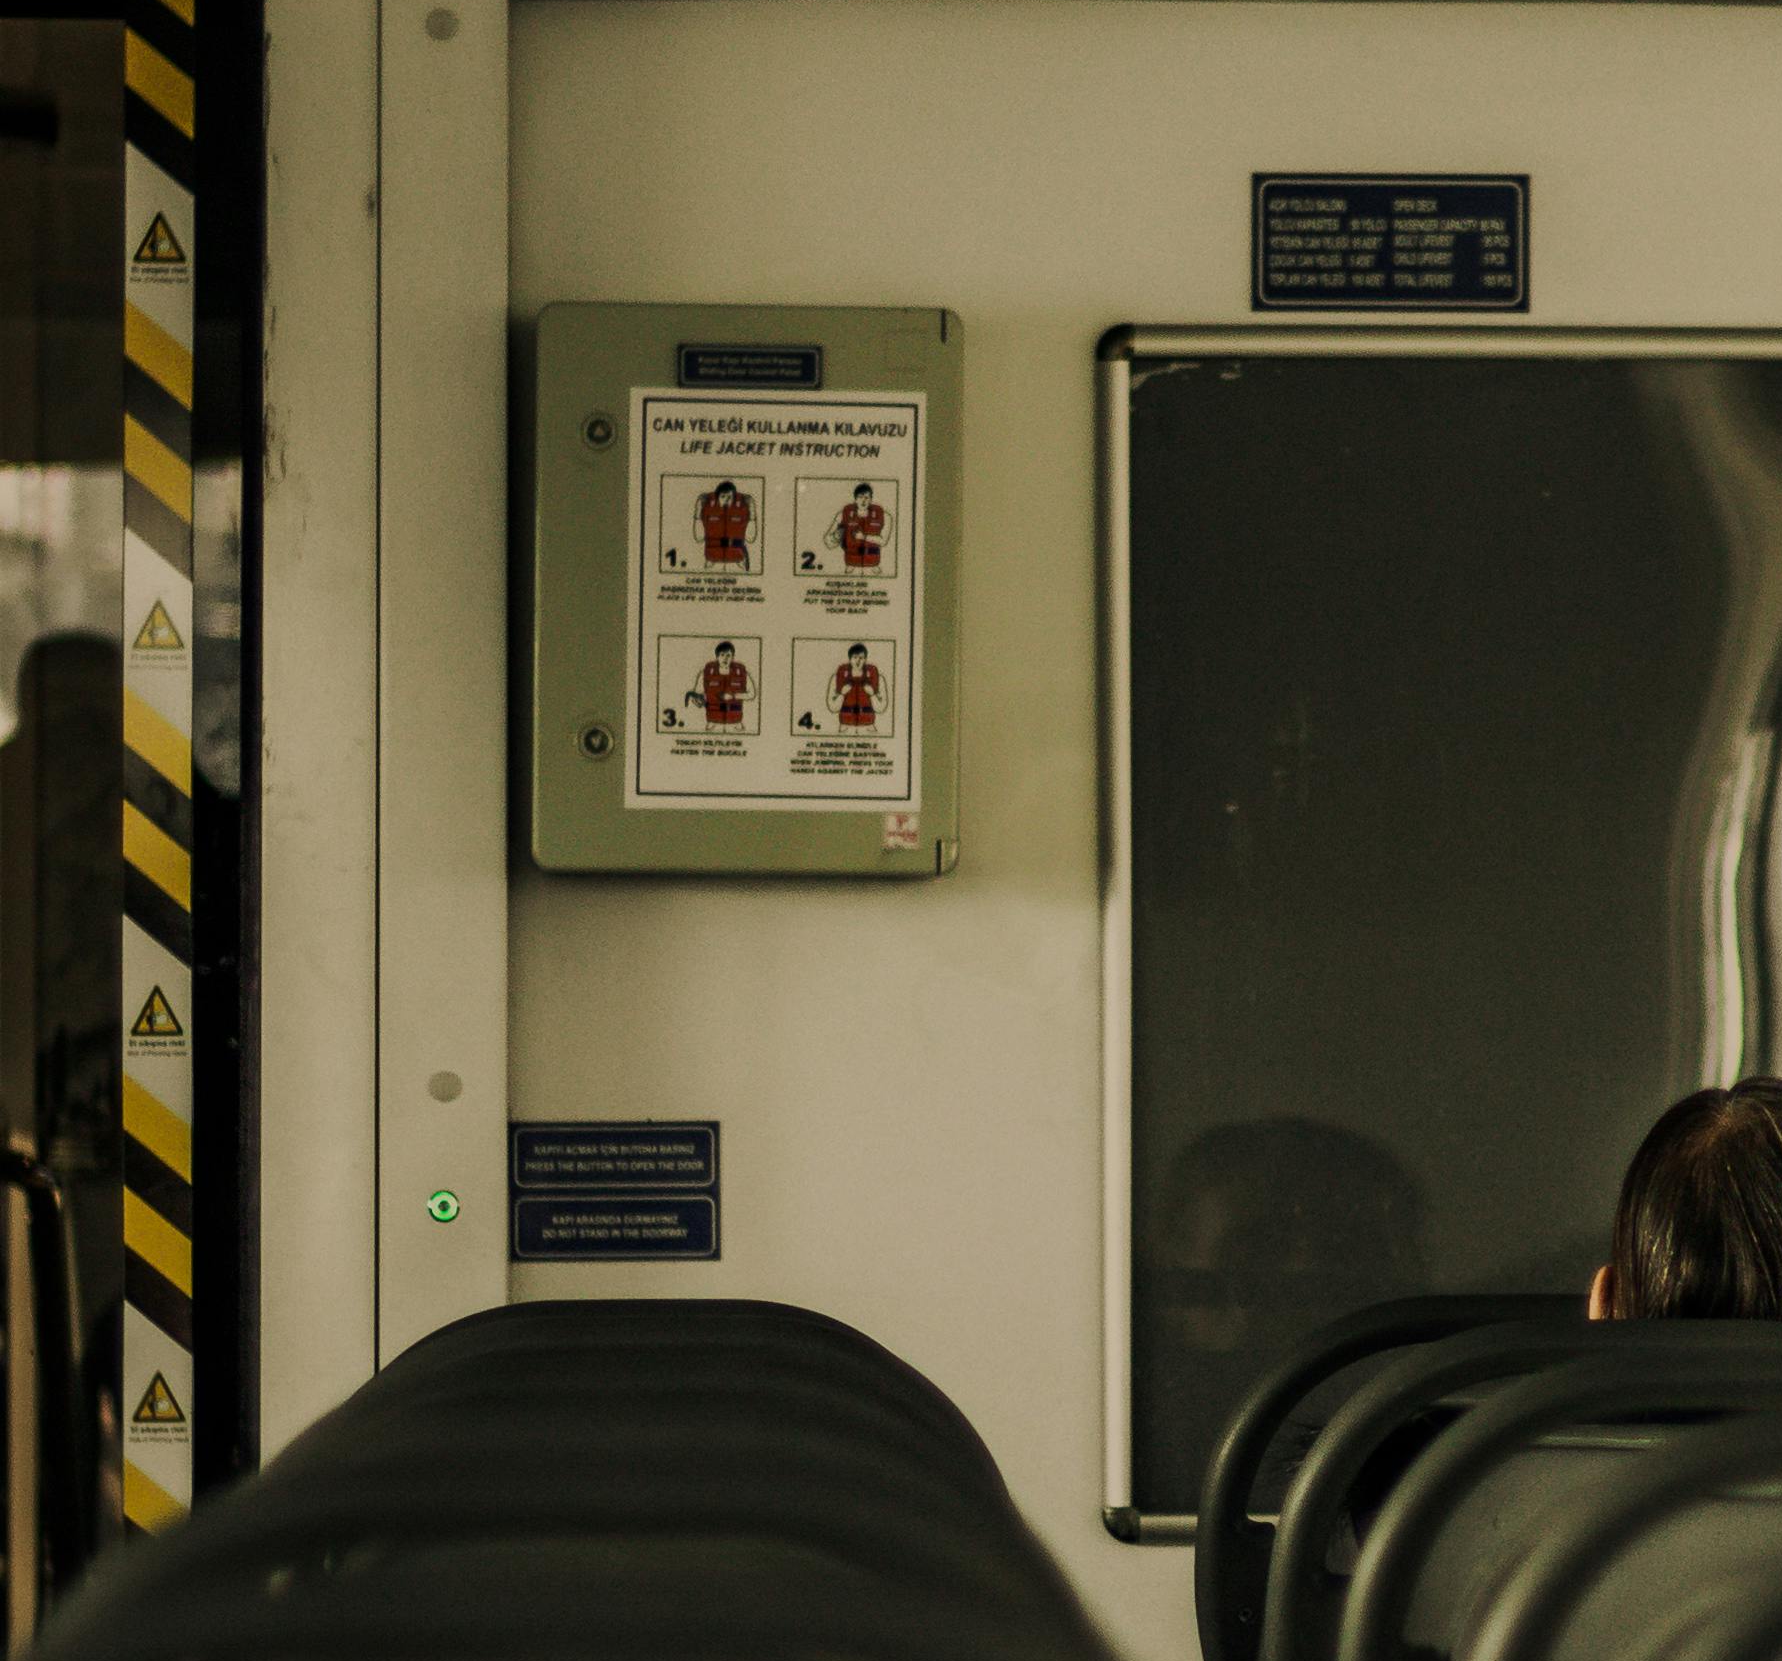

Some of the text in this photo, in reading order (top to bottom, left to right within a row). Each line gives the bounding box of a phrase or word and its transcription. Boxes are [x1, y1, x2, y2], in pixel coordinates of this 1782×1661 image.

[653, 417, 907, 437] CAN YELEĞİ KULLANMA KILAVUZU
[680, 440, 880, 458] LIFE JACKET INSTRUCTION
[665, 548, 687, 567] 1.
[801, 551, 823, 570] 2.
[662, 708, 685, 727] 3.
[798, 711, 821, 730] 4.
